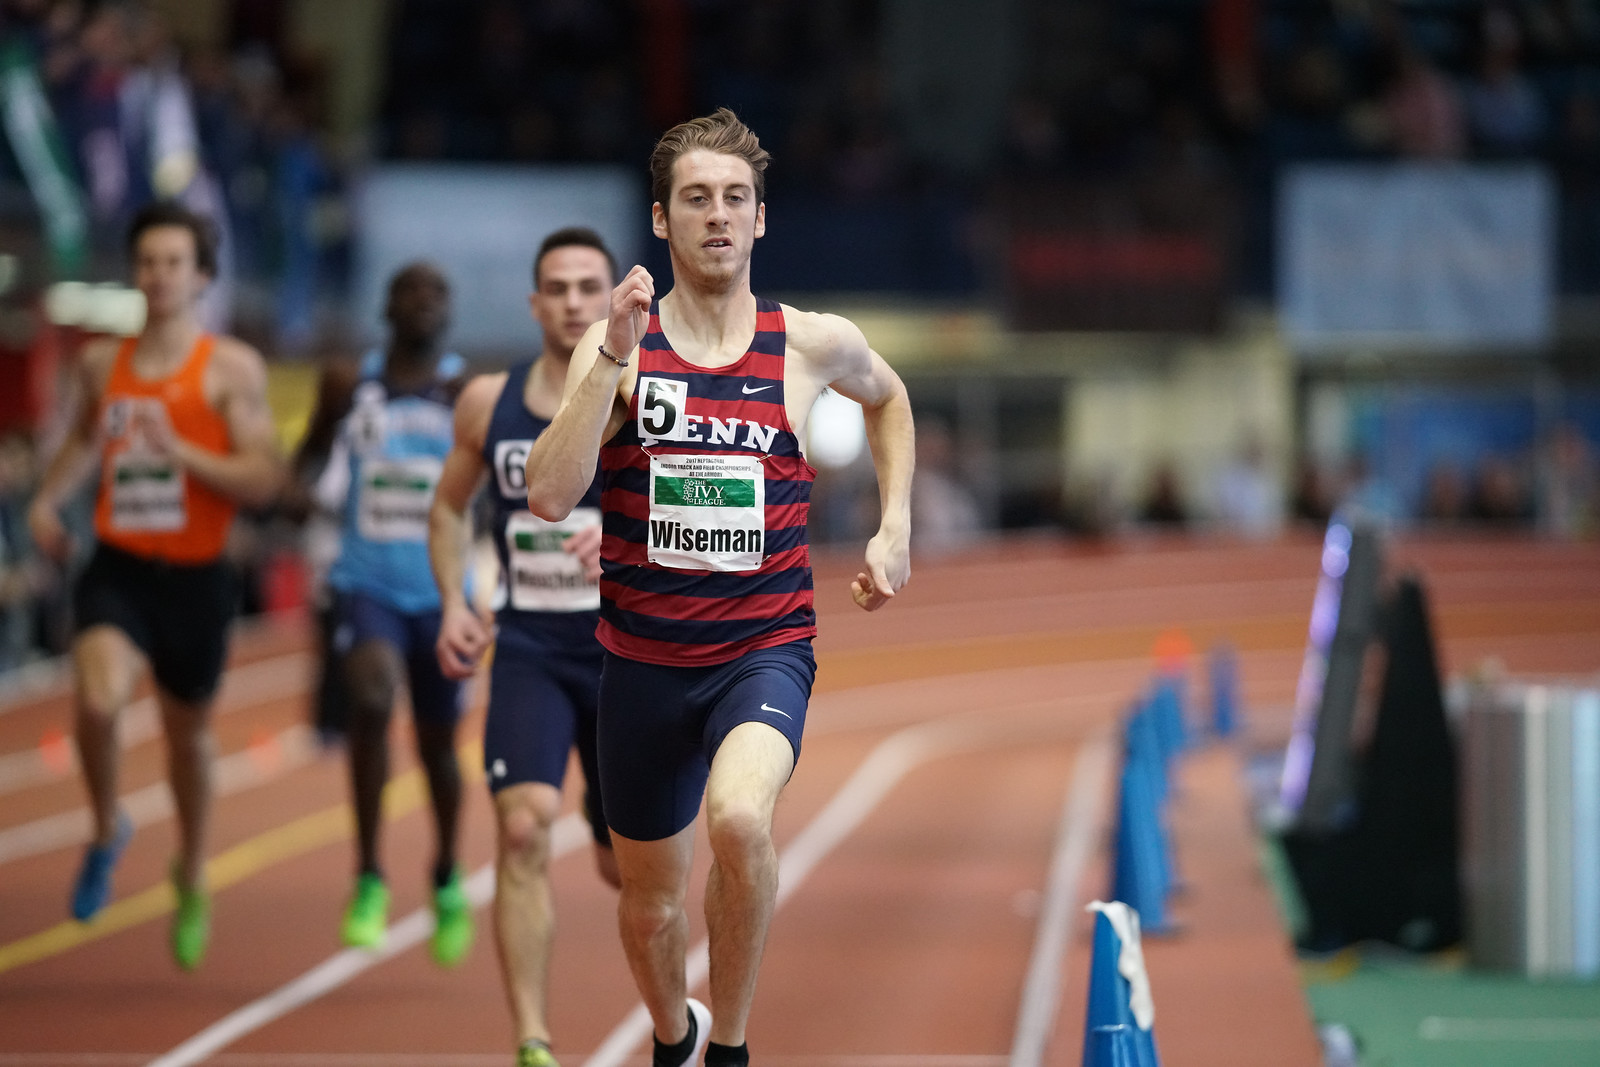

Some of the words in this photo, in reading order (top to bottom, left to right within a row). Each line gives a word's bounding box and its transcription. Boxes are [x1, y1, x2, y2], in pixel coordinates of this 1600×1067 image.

[642, 381, 678, 435] 5
[641, 413, 780, 453] ENN
[504, 447, 527, 490] 6
[693, 498, 725, 506] LEAGUE
[694, 485, 725, 499] IVY
[650, 519, 762, 553] Wiseman
